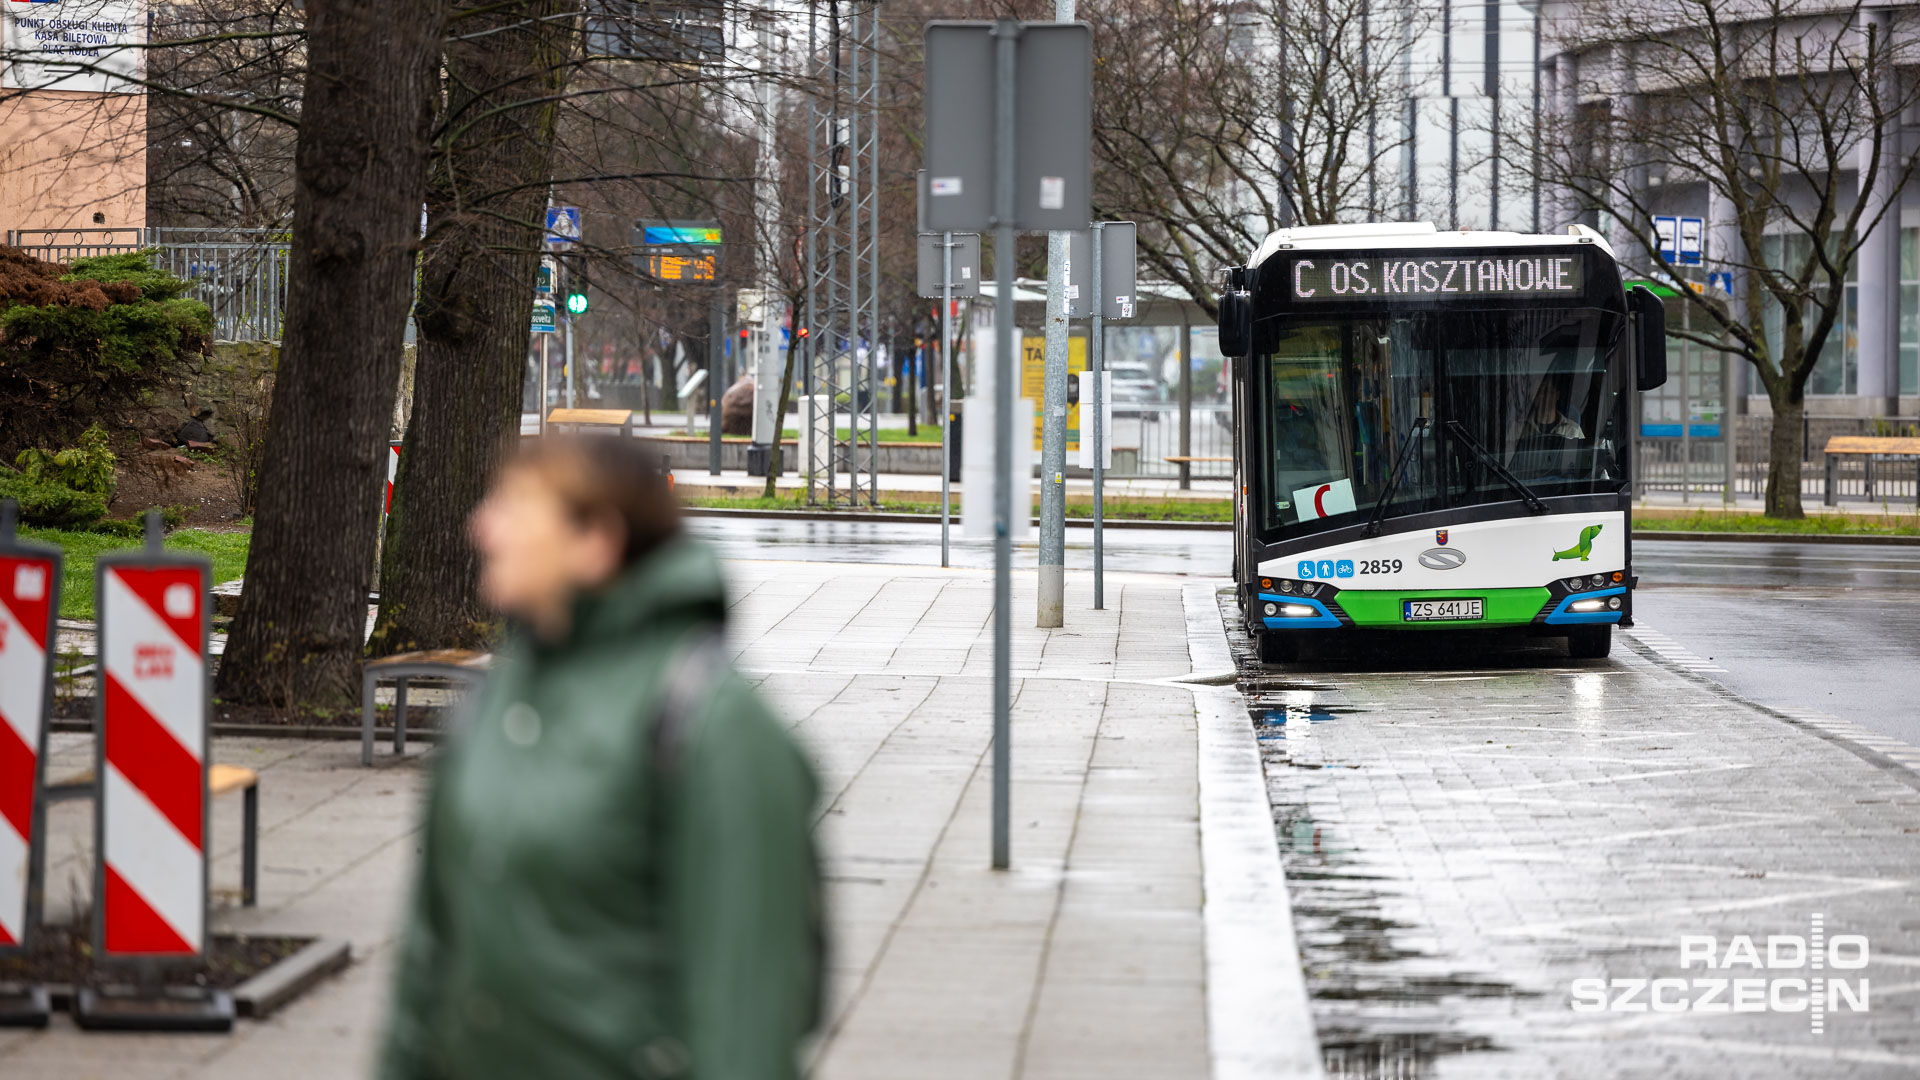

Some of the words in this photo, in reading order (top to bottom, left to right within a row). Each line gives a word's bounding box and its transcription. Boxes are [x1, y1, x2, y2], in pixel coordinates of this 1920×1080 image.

[15, 18, 45, 29] PUNKT
[49, 19, 88, 30] OBSŁUGI
[92, 21, 128, 33] KLIENTA
[35, 31, 59, 41] KASA
[63, 32, 108, 44] BILETOWA
[42, 44, 65, 55] PLAC
[68, 45, 100, 57] RODŁA
[1295, 260, 1316, 298] C
[1314, 484, 1331, 518] C
[1359, 559, 1403, 575] 2859
[1413, 603, 1433, 617] ZS
